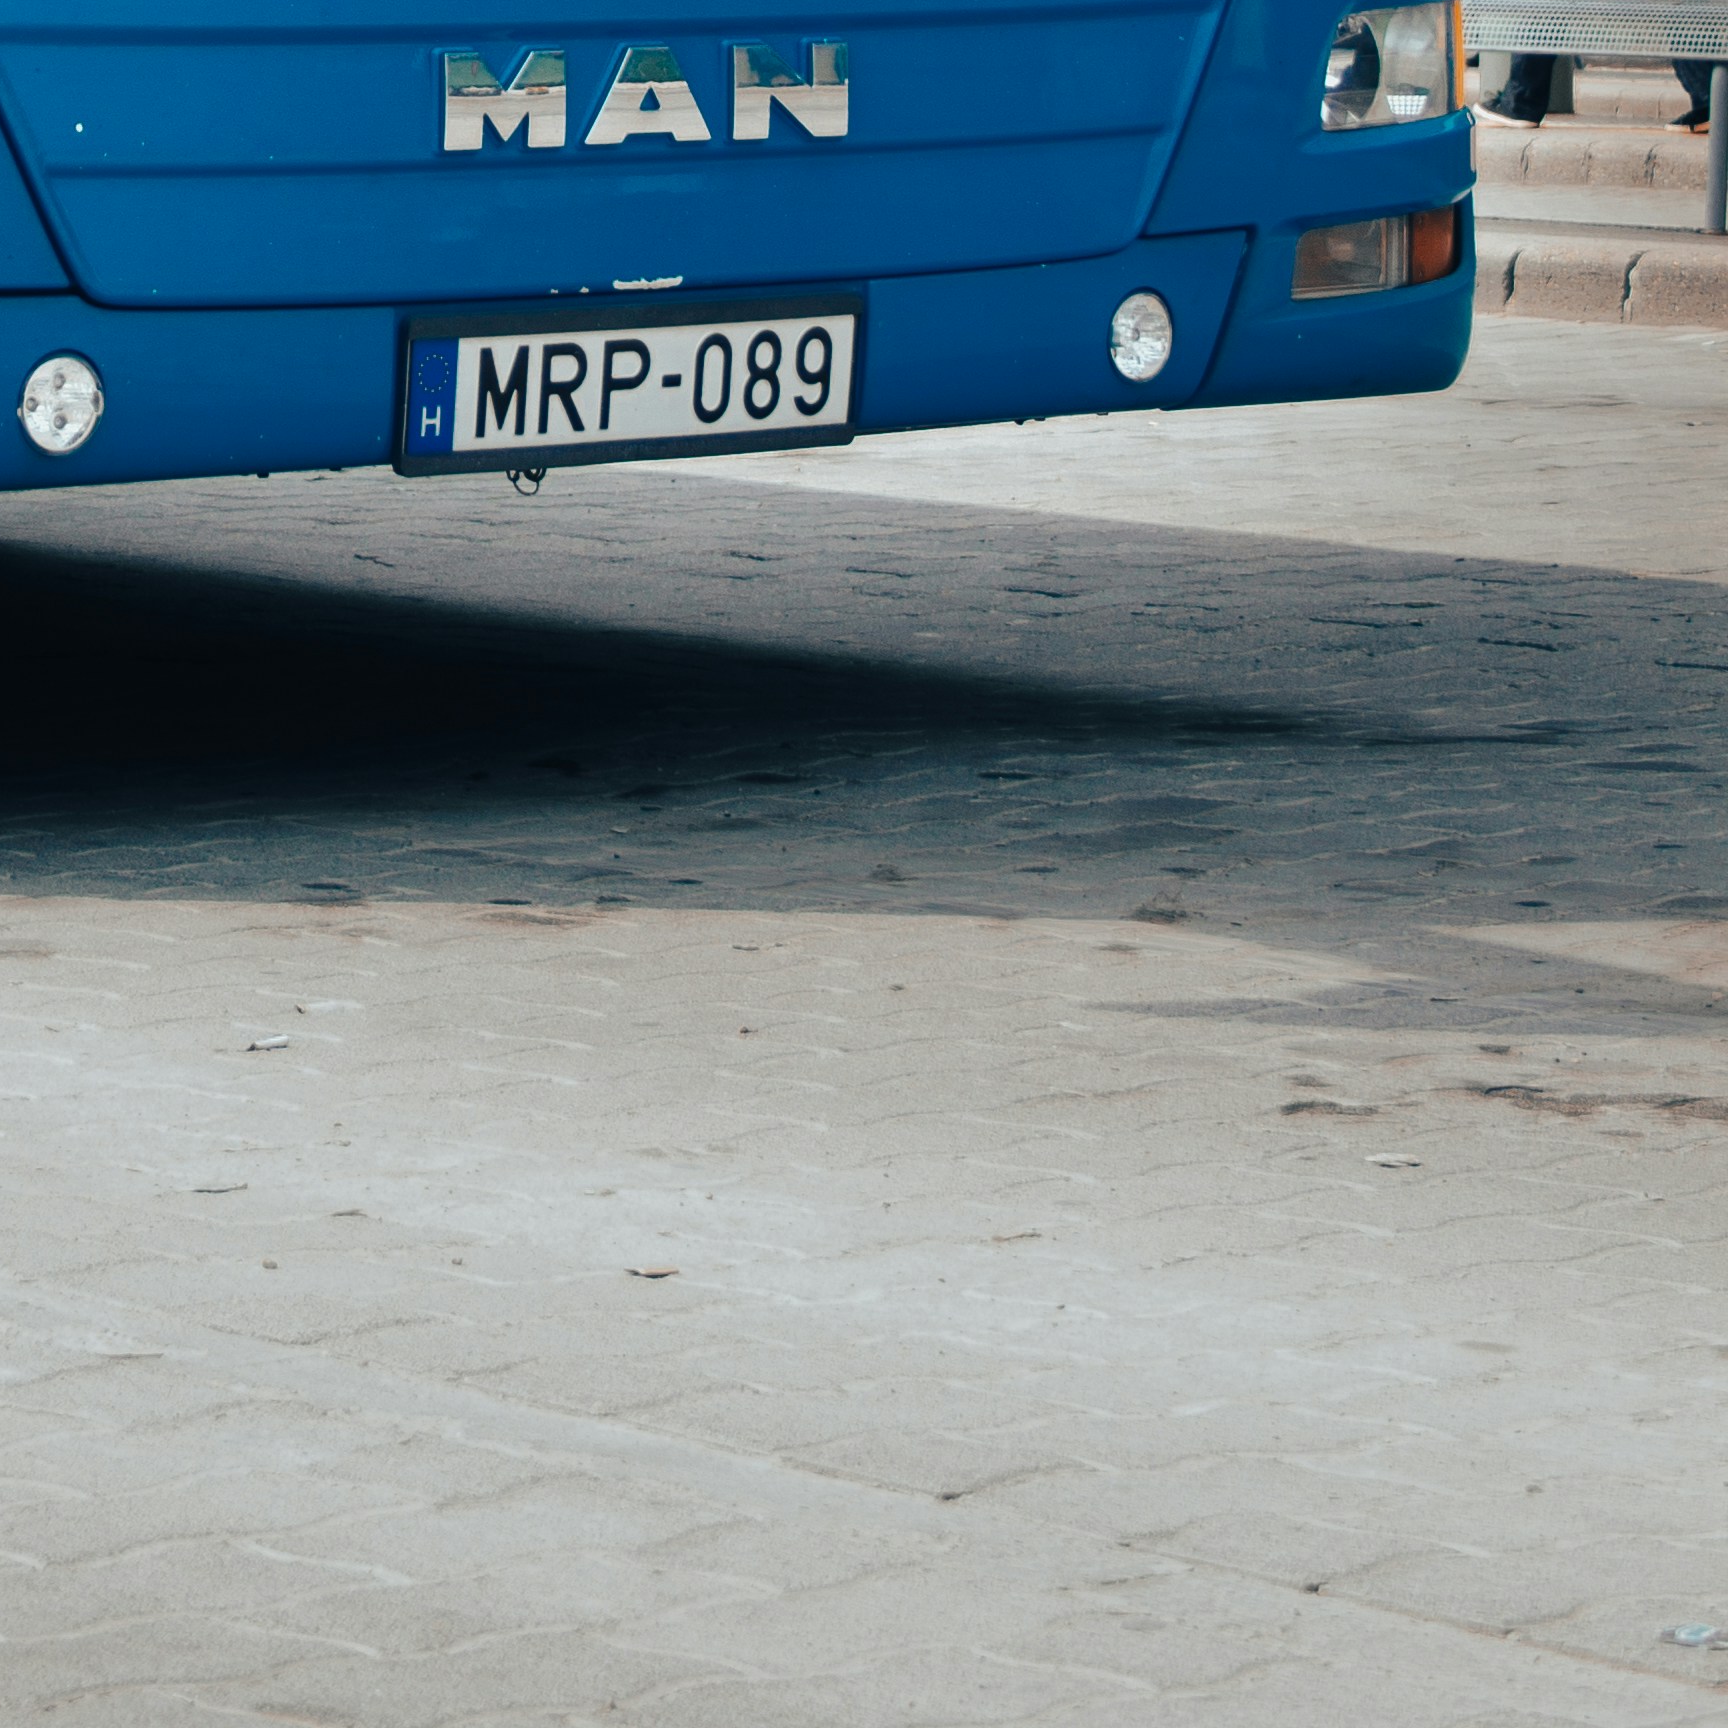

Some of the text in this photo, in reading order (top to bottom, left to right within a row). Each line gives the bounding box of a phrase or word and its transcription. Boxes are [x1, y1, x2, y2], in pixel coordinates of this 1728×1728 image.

[443, 39, 849, 151] MAN
[421, 326, 833, 439] H MRP-089
